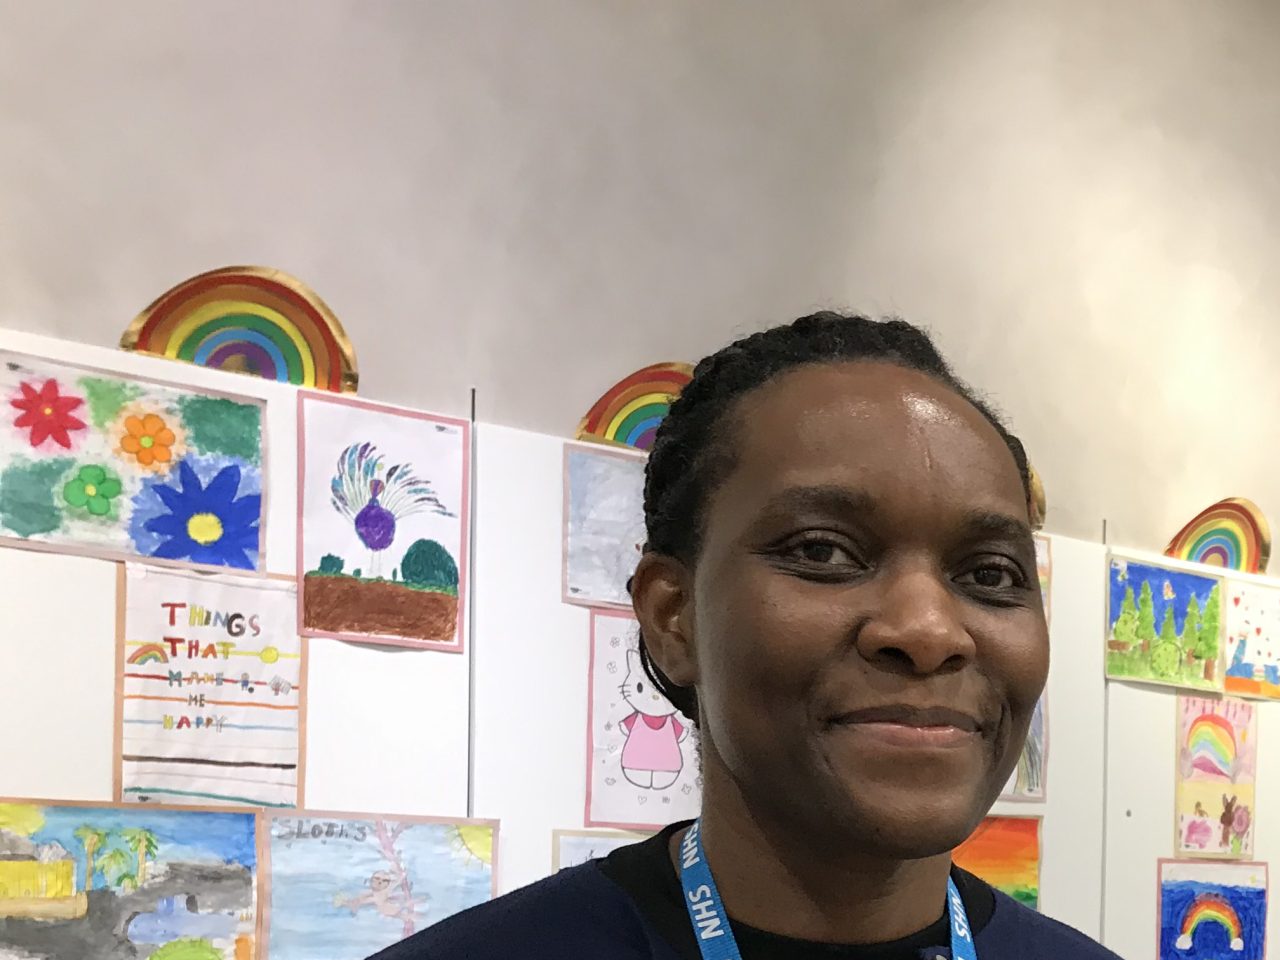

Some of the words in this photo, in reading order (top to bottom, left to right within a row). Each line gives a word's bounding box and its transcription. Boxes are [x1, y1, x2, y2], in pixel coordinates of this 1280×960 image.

[161, 603, 261, 637] THINGS
[163, 637, 236, 660] THAT
[188, 693, 205, 708] ME
[683, 823, 700, 869] NHS
[689, 884, 725, 940] NHS
[951, 891, 970, 943] NHS
